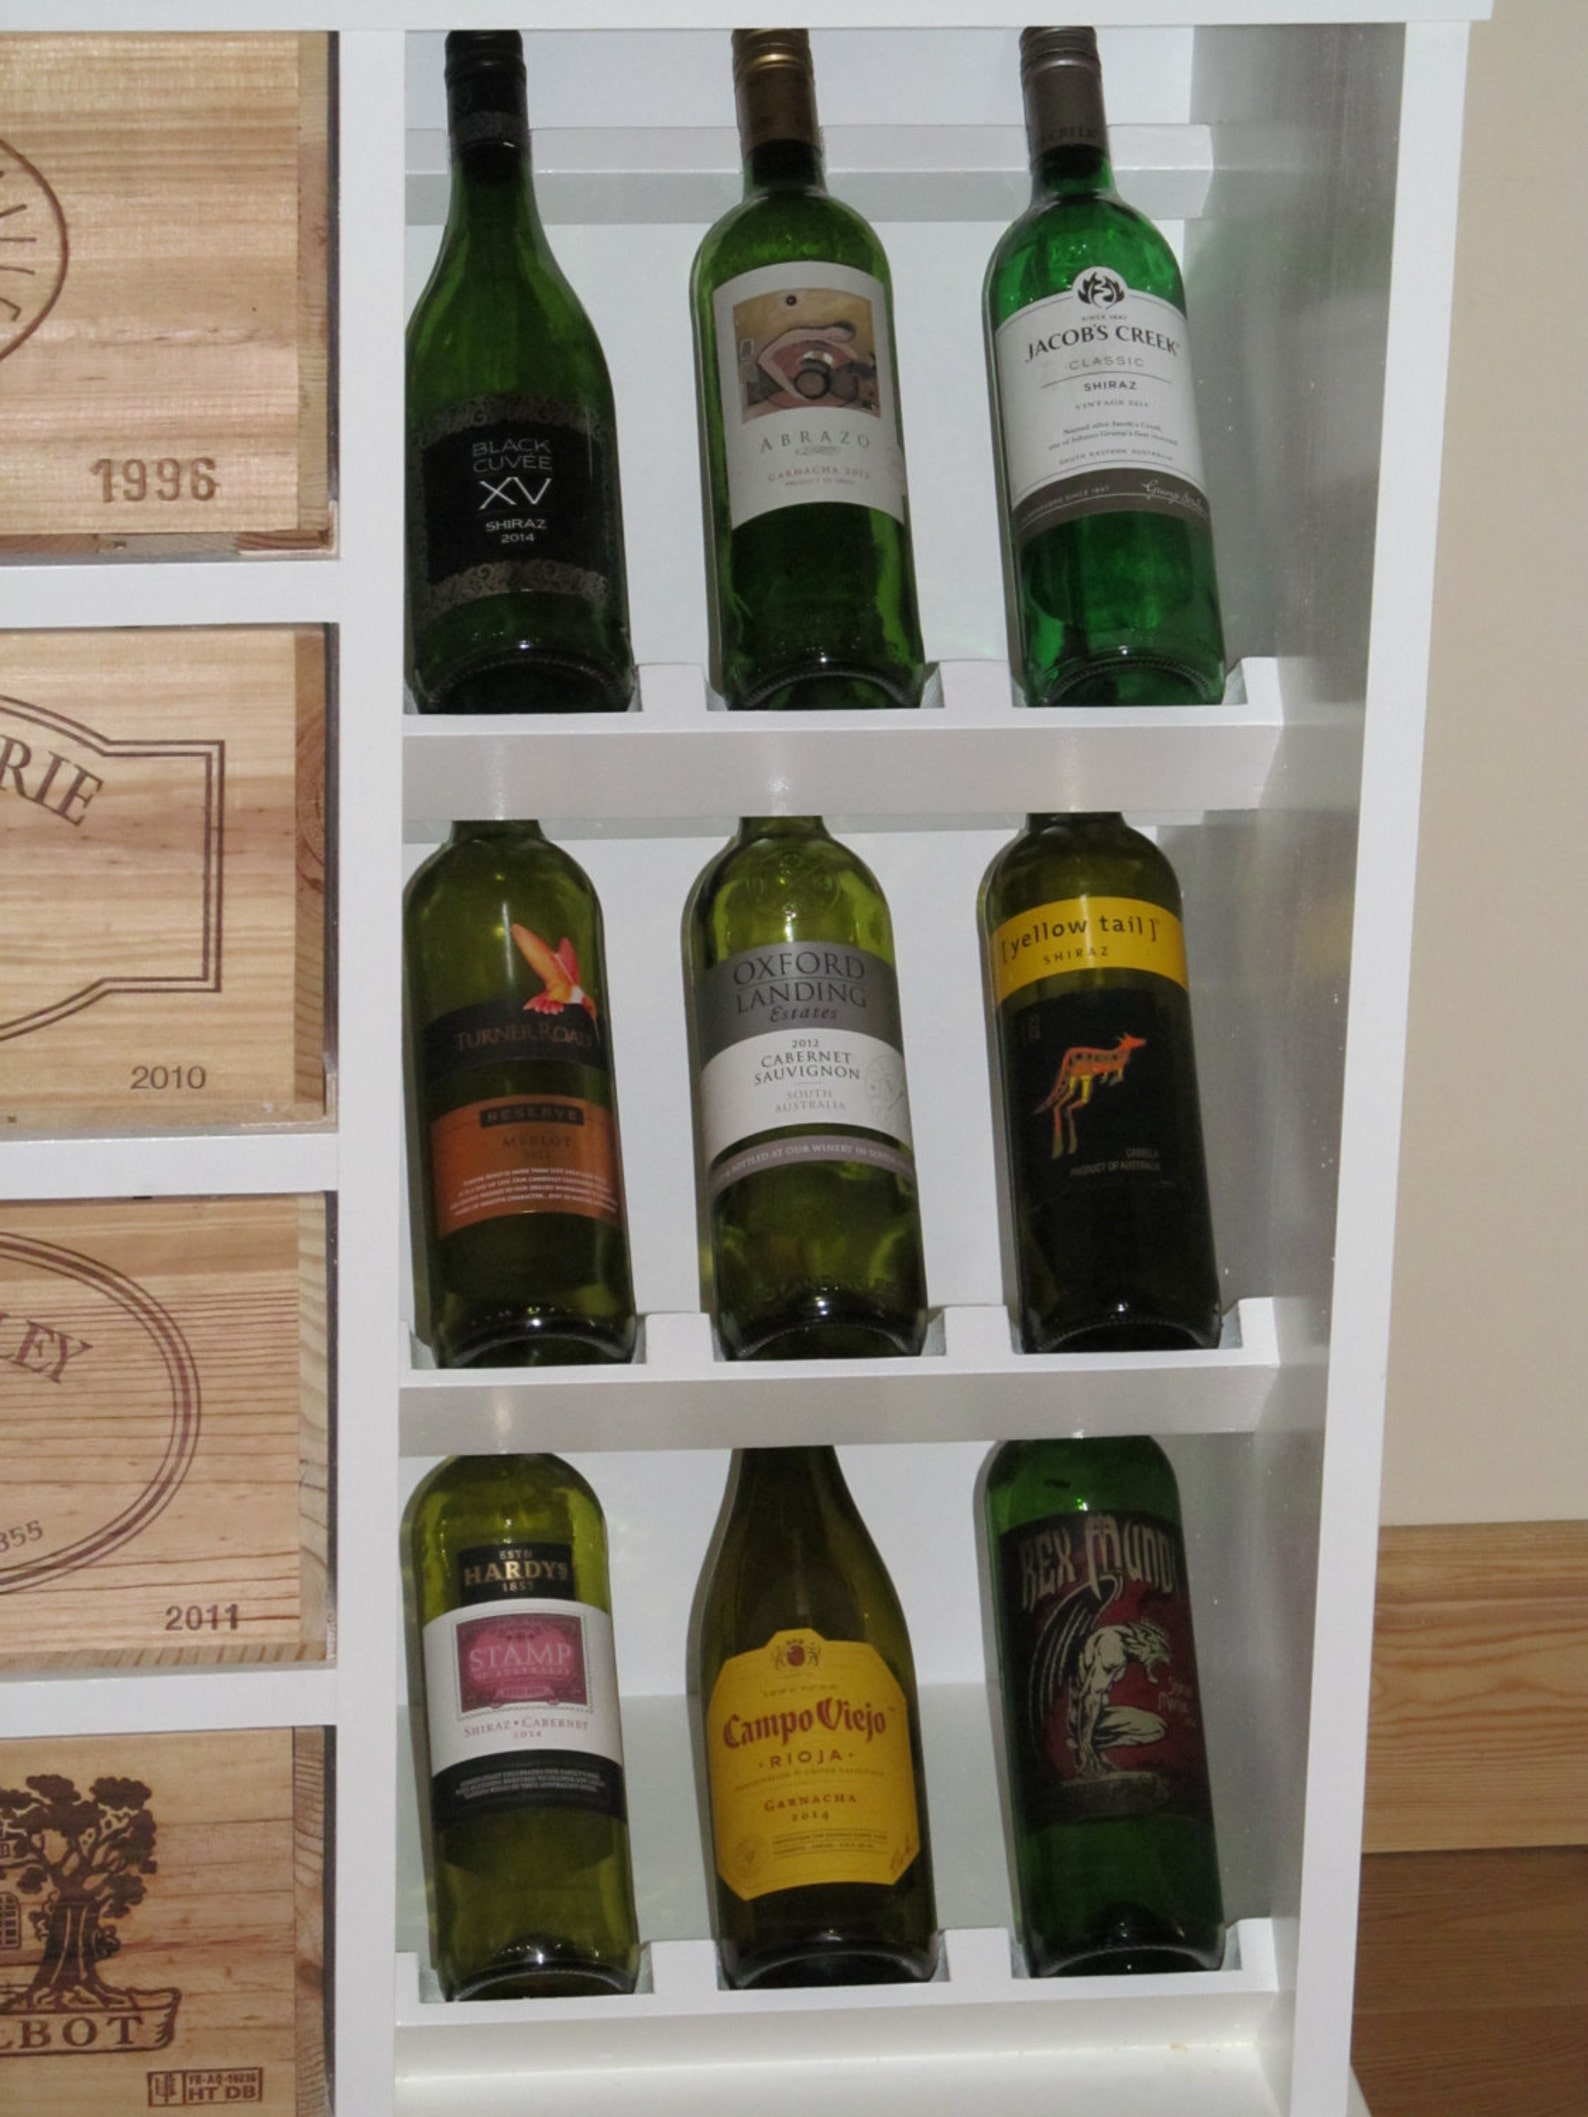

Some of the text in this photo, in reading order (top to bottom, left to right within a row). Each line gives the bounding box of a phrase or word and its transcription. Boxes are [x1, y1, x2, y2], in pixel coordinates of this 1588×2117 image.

[1025, 323, 1178, 363] JACOB'S CREEK
[1068, 356, 1145, 370] CLASSIC
[1083, 380, 1138, 391] SHIRAZ
[472, 438, 552, 457] BLACK
[760, 430, 871, 454] ABRAZO
[90, 457, 218, 502] 1996
[478, 476, 552, 510] XV
[485, 518, 547, 532] SHIRAZ
[501, 532, 535, 543] 2014
[1044, 946, 1109, 966] SHIRAZ
[733, 951, 866, 986] OXFORD
[736, 981, 867, 1014] LANDING
[769, 1005, 838, 1022] Estates
[760, 1051, 852, 1068] CABERNET
[130, 1066, 206, 1090] 2010
[754, 1065, 861, 1085] SAUVIGNON
[785, 1088, 832, 1099] SOUTH
[486, 1105, 579, 1122] RESERVE
[774, 1101, 846, 1113] AUSTRALIA
[464, 1561, 568, 1586] HARDYS
[502, 1581, 534, 1591] 1853
[165, 1604, 239, 1631] 2011
[469, 1639, 573, 1669] STAMP
[464, 1716, 589, 1738] SHIRAZ CABERNET
[723, 1696, 886, 1748] Campo Viejo
[770, 1750, 842, 1769] RIOJA
[763, 1794, 857, 1812] GARNACHA
[0, 2015, 144, 2050] BOT
[188, 2086, 219, 2101] HT
[225, 2085, 256, 2100] DB
